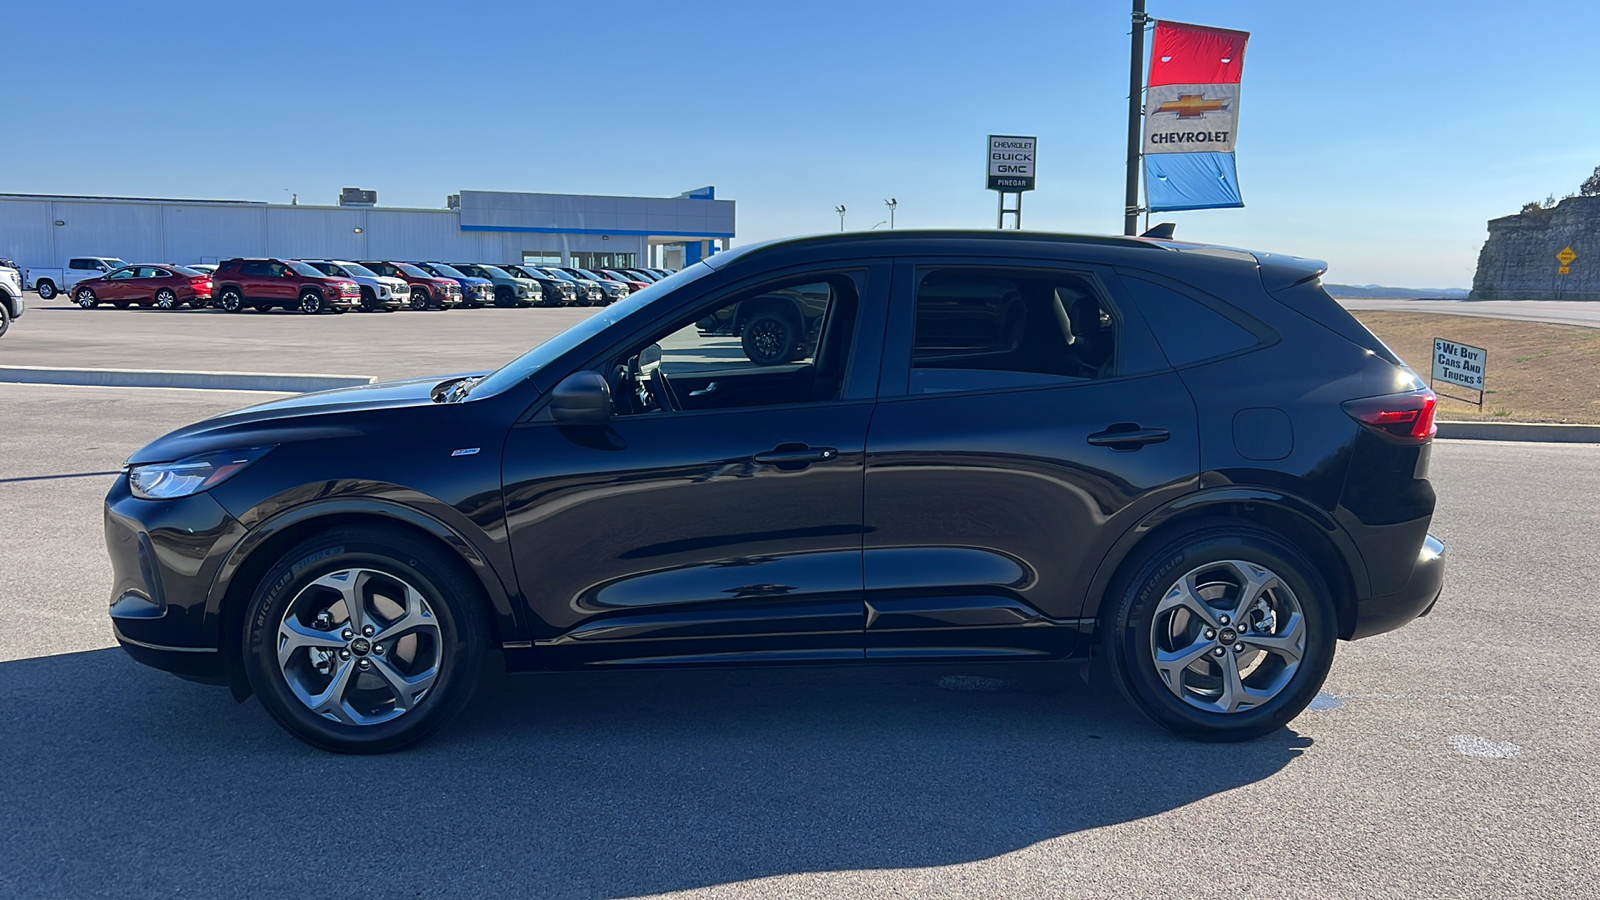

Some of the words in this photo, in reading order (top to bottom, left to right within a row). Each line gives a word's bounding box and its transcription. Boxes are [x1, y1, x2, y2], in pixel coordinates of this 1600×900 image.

[1151, 131, 1229, 144] CHEVROLET
[993, 141, 1033, 149] CHEVROLET
[992, 153, 1033, 161] BUICK
[998, 165, 1027, 173] GMC
[997, 179, 1027, 187] PINEGAR
[1460, 347, 1478, 361] BUY
[1438, 353, 1461, 369] CARS
[1462, 360, 1481, 374] AND
[1442, 366, 1475, 385] TRUCKS
[1140, 553, 1184, 603] MICHELIN
[257, 571, 293, 627] MICHELIN
